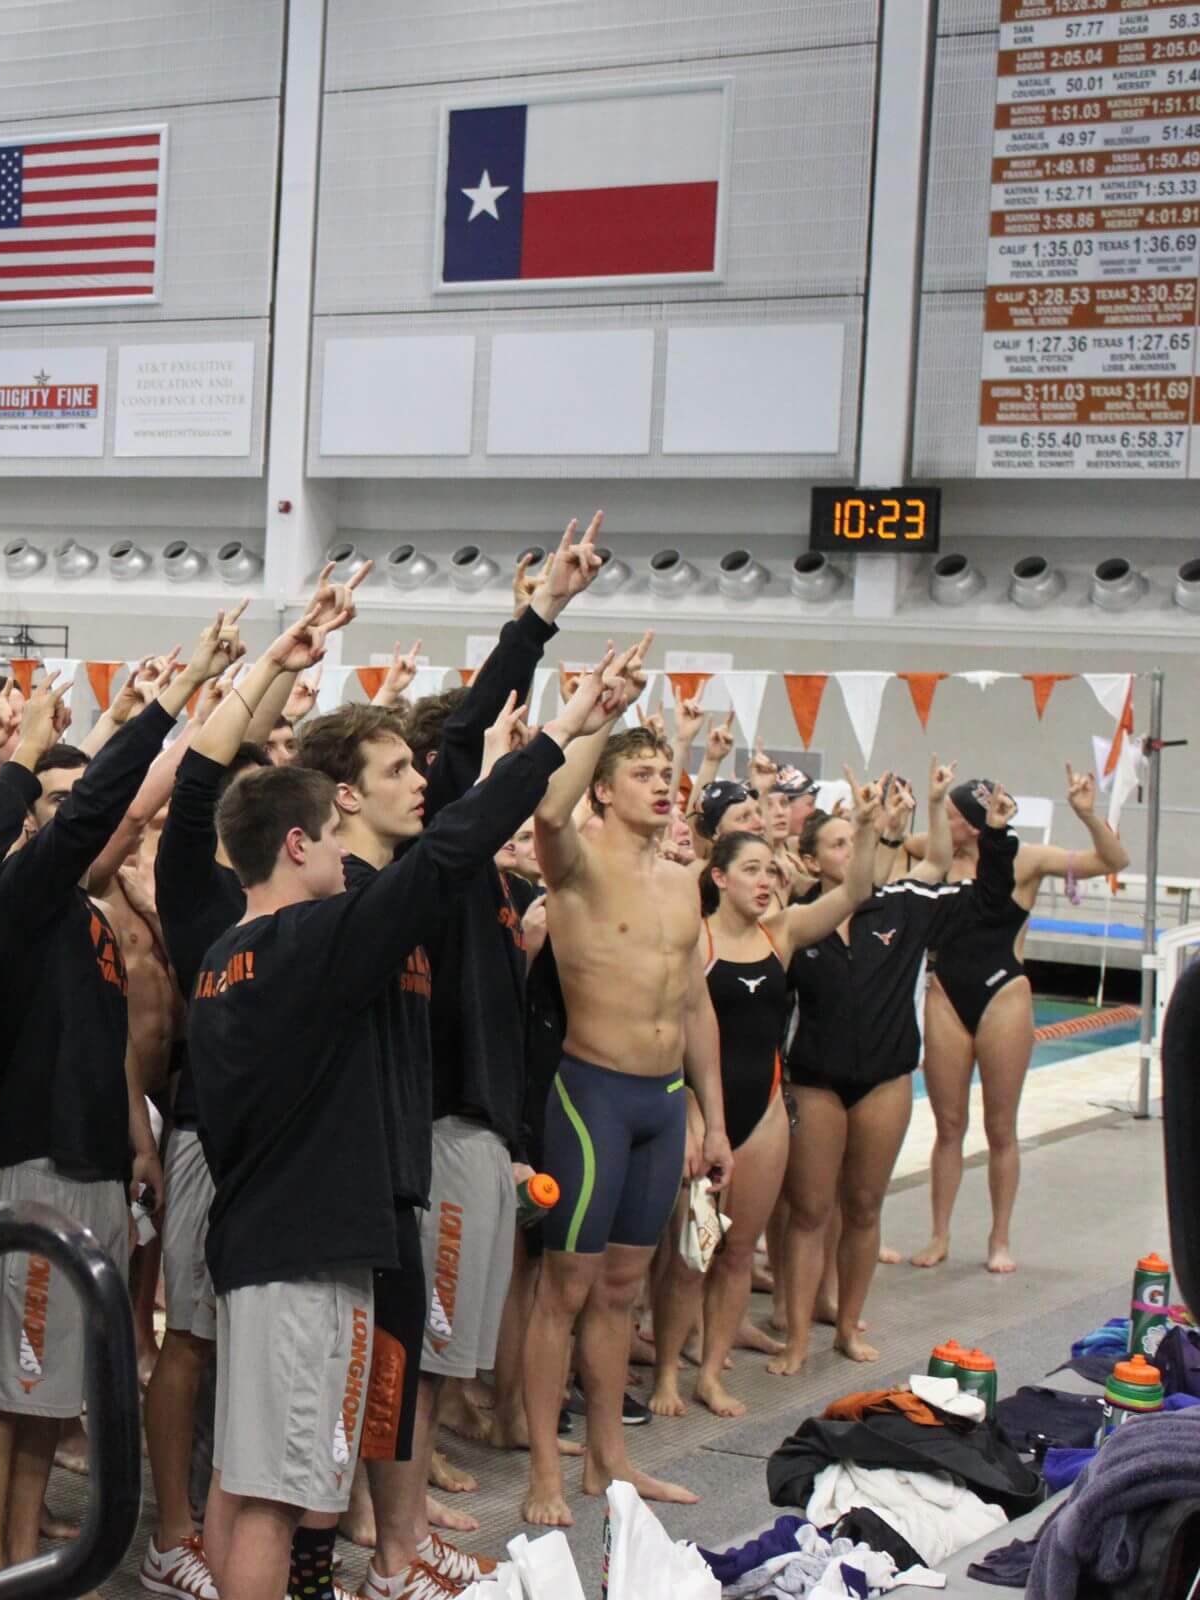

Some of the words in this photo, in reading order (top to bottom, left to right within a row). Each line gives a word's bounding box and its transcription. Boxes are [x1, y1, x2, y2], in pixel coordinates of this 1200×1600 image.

[1065, 21, 1104, 38] 57.77
[1050, 48, 1103, 68] 2:05.04
[1066, 76, 1103, 93] 50.01
[1050, 103, 1101, 122] 1:51.03
[1058, 130, 1095, 147] 49.97
[1044, 158, 1095, 175] 1:49.18
[1147, 151, 1200, 169] 1:50.49
[1045, 186, 1093, 202] 1:52.71
[1144, 179, 1197, 197] 1:53.33
[1145, 206, 1200, 225] 4:01.91
[1033, 239, 1093, 258] 1:35.03
[1098, 240, 1130, 252] TEXAS
[1133, 234, 1197, 254] 1:36.69
[1028, 287, 1090, 306] 3:28.53
[1096, 289, 1128, 300] TEXAS
[1130, 284, 1195, 303] 3:30.52
[994, 339, 1021, 350] CALIF
[1027, 336, 1088, 353] 1:27.36
[1092, 338, 1123, 348] TEXAS
[1128, 333, 1191, 351] 1:27.65
[137, 361, 168, 373] AT&T
[170, 360, 233, 372] EXECUTIVE
[137, 378, 203, 390] EDUCATION
[208, 376, 233, 388] AND
[1090, 386, 1122, 397] TEXAS
[1124, 382, 1189, 400] 3:11.69
[56, 387, 93, 407] FINE
[121, 395, 195, 407] CONFERENCE
[200, 394, 246, 406] CENTER
[1024, 384, 1085, 401] 3:11.03
[1021, 432, 1082, 448] 6:55.40
[1086, 434, 1116, 444] TEXAS
[1120, 431, 1184, 448] 6:58.37
[833, 499, 925, 539] 10:23
[1142, 1285, 1165, 1307] G
[19, 1253, 52, 1376] ONGHORNS
